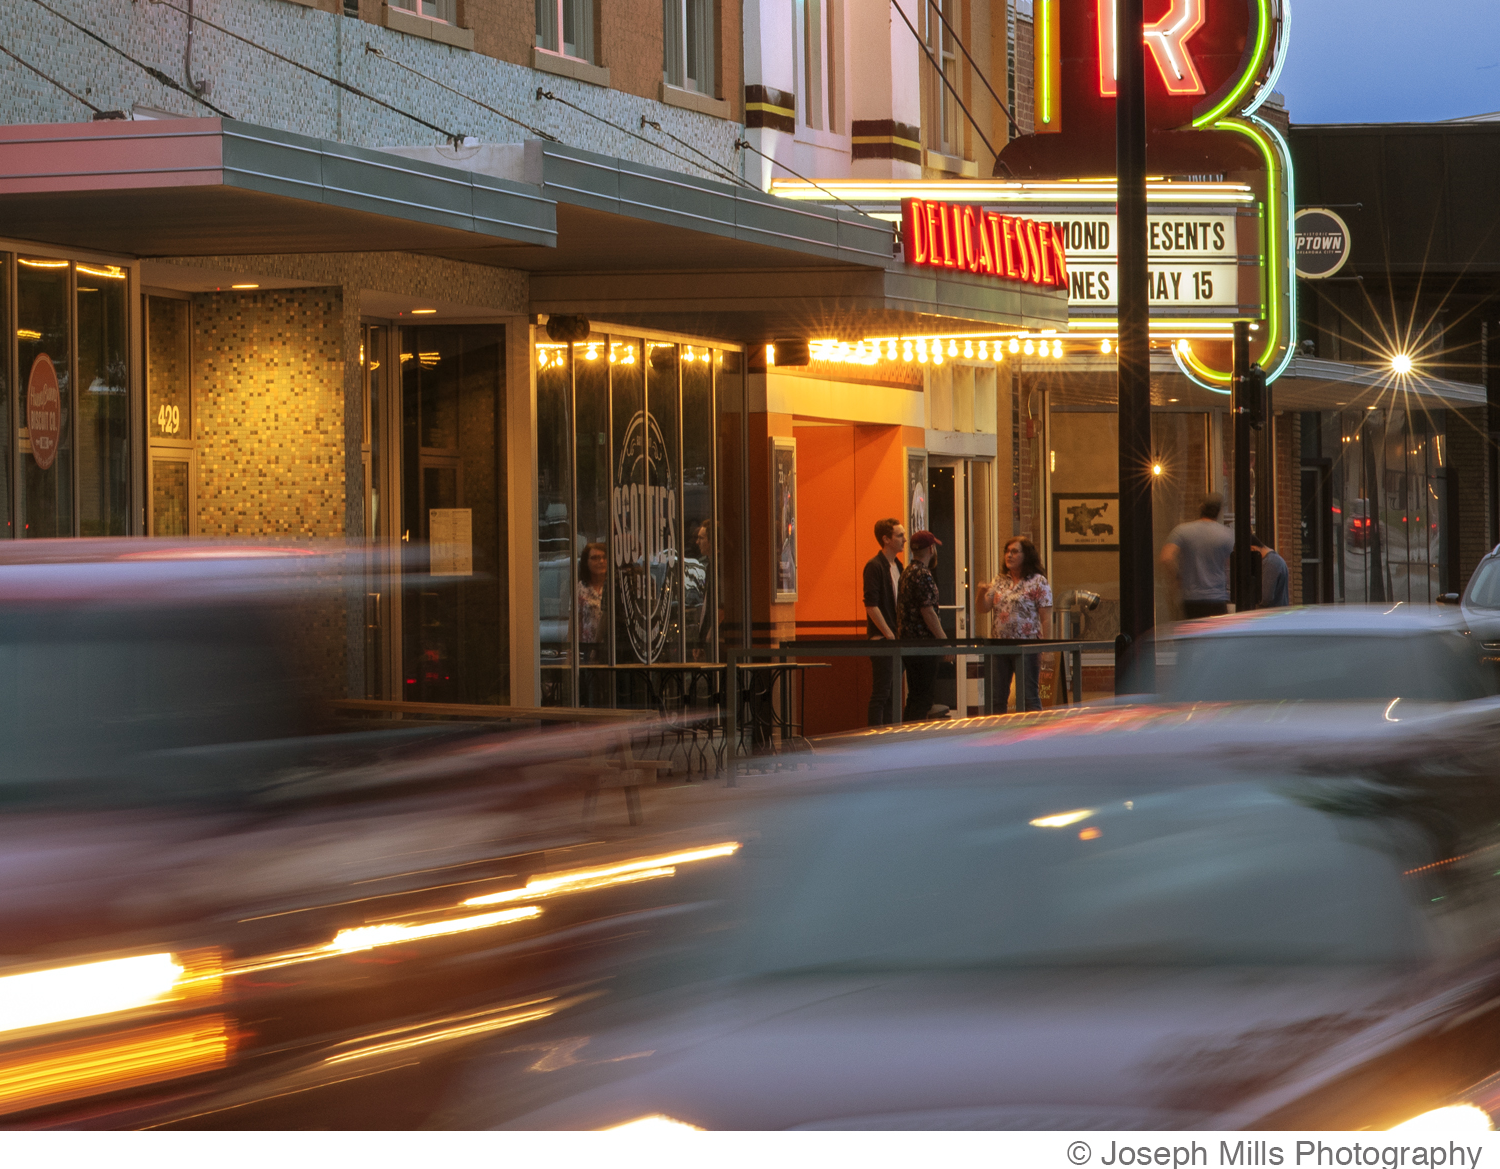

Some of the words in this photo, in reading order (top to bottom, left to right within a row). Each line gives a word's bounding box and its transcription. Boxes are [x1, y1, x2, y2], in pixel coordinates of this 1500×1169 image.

[911, 197, 1067, 286] DELICATESSEN
[1150, 221, 1225, 251] ESENTS
[1295, 236, 1342, 250] PTOWN
[1193, 271, 1213, 300] 15
[158, 404, 180, 434] 429
